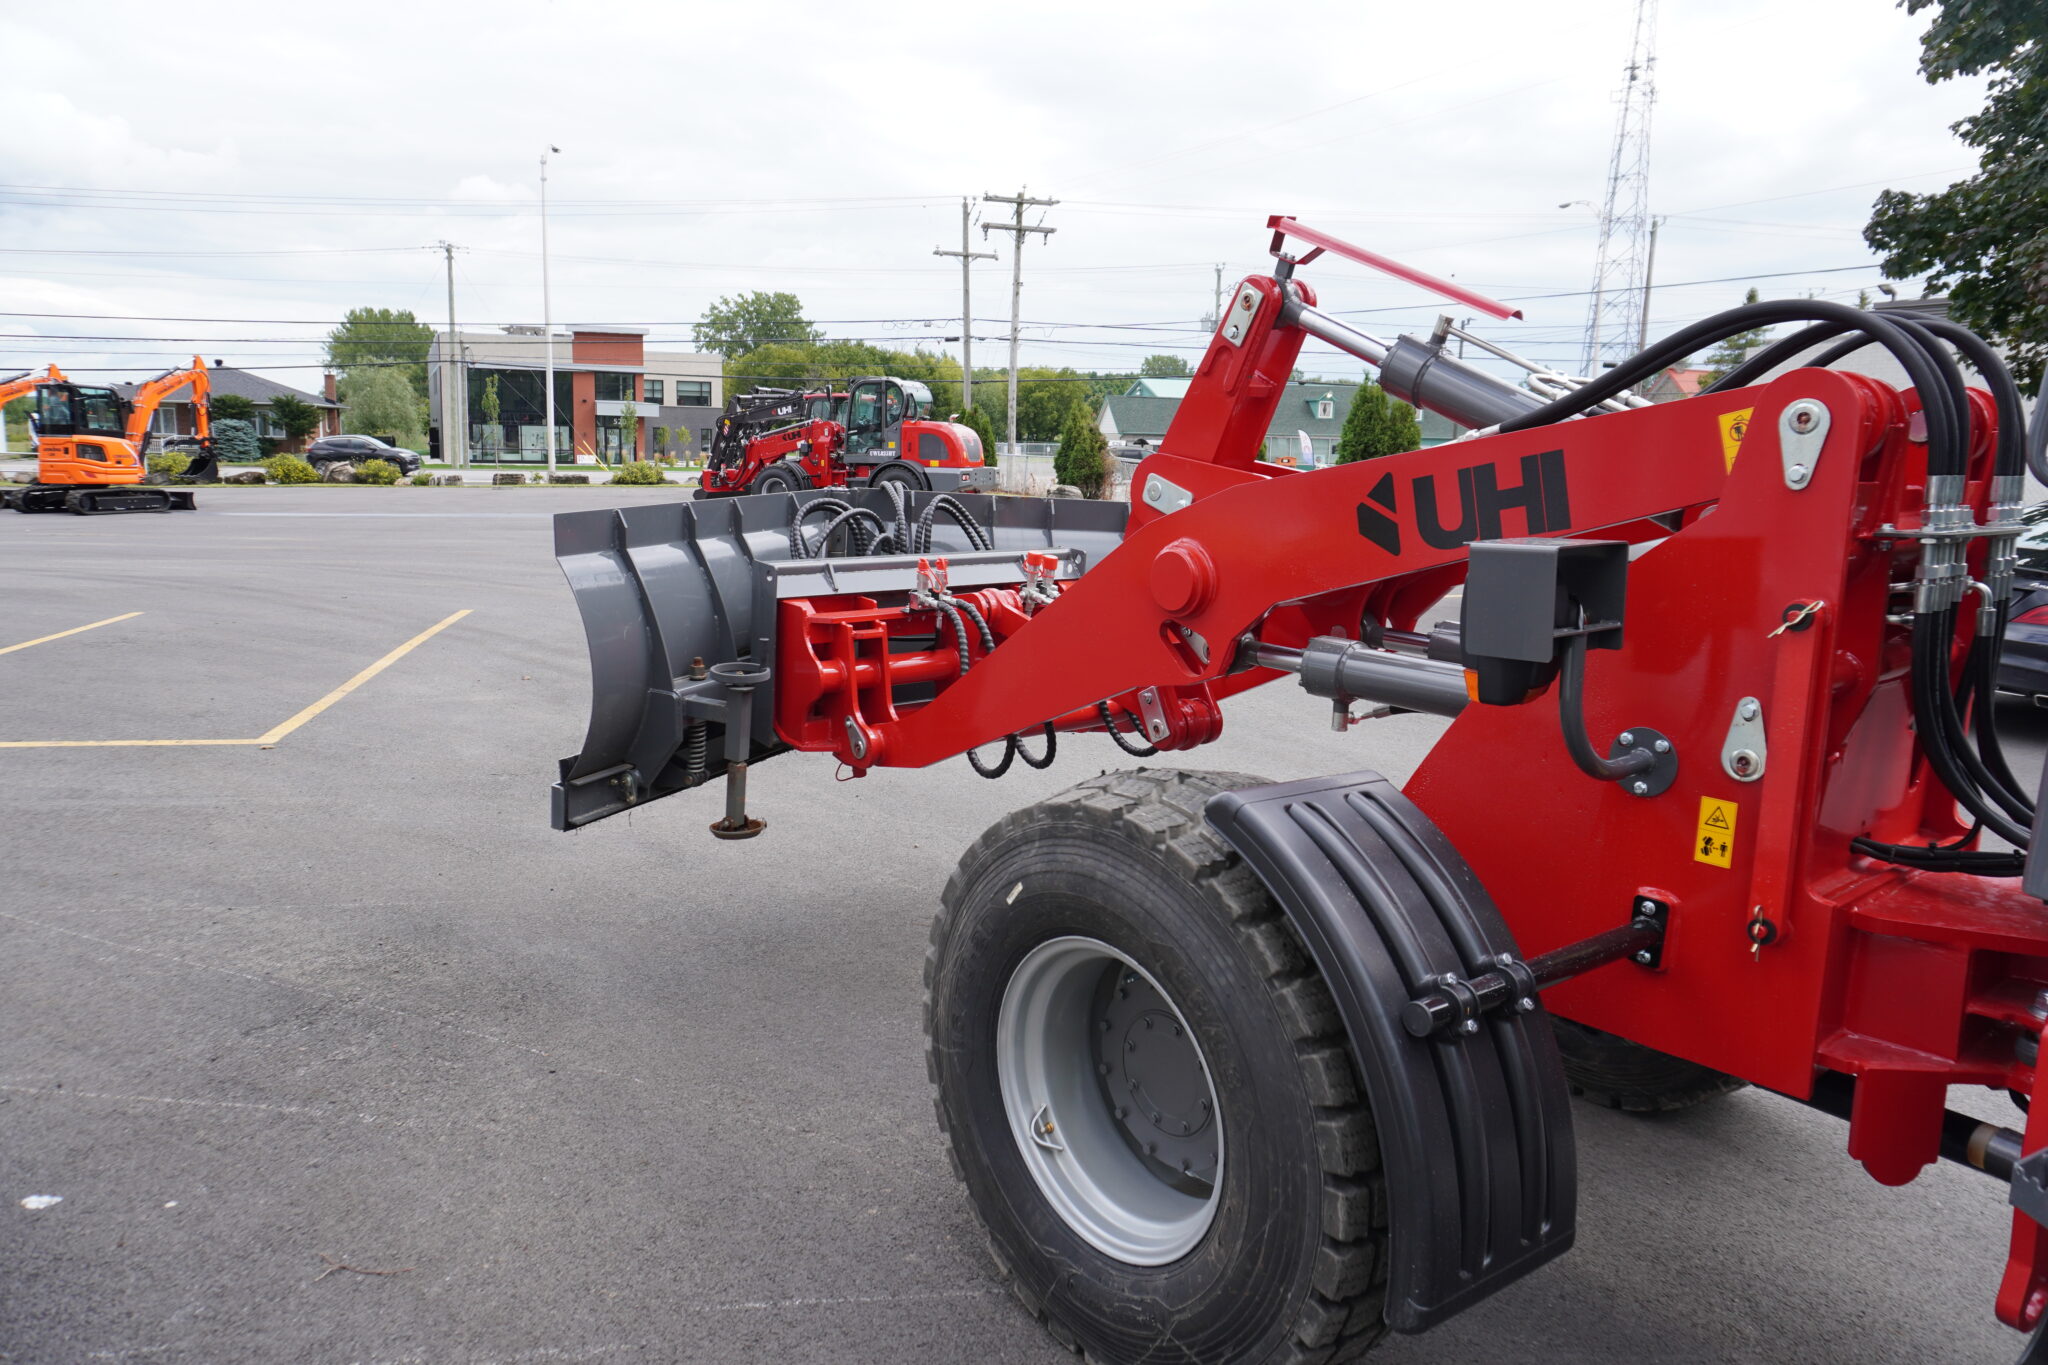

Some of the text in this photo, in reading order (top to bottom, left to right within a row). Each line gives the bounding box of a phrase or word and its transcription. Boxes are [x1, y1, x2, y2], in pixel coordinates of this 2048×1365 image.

[777, 405, 792, 415] UHI
[787, 430, 801, 441] UHI
[1412, 449, 1572, 549] UHI
